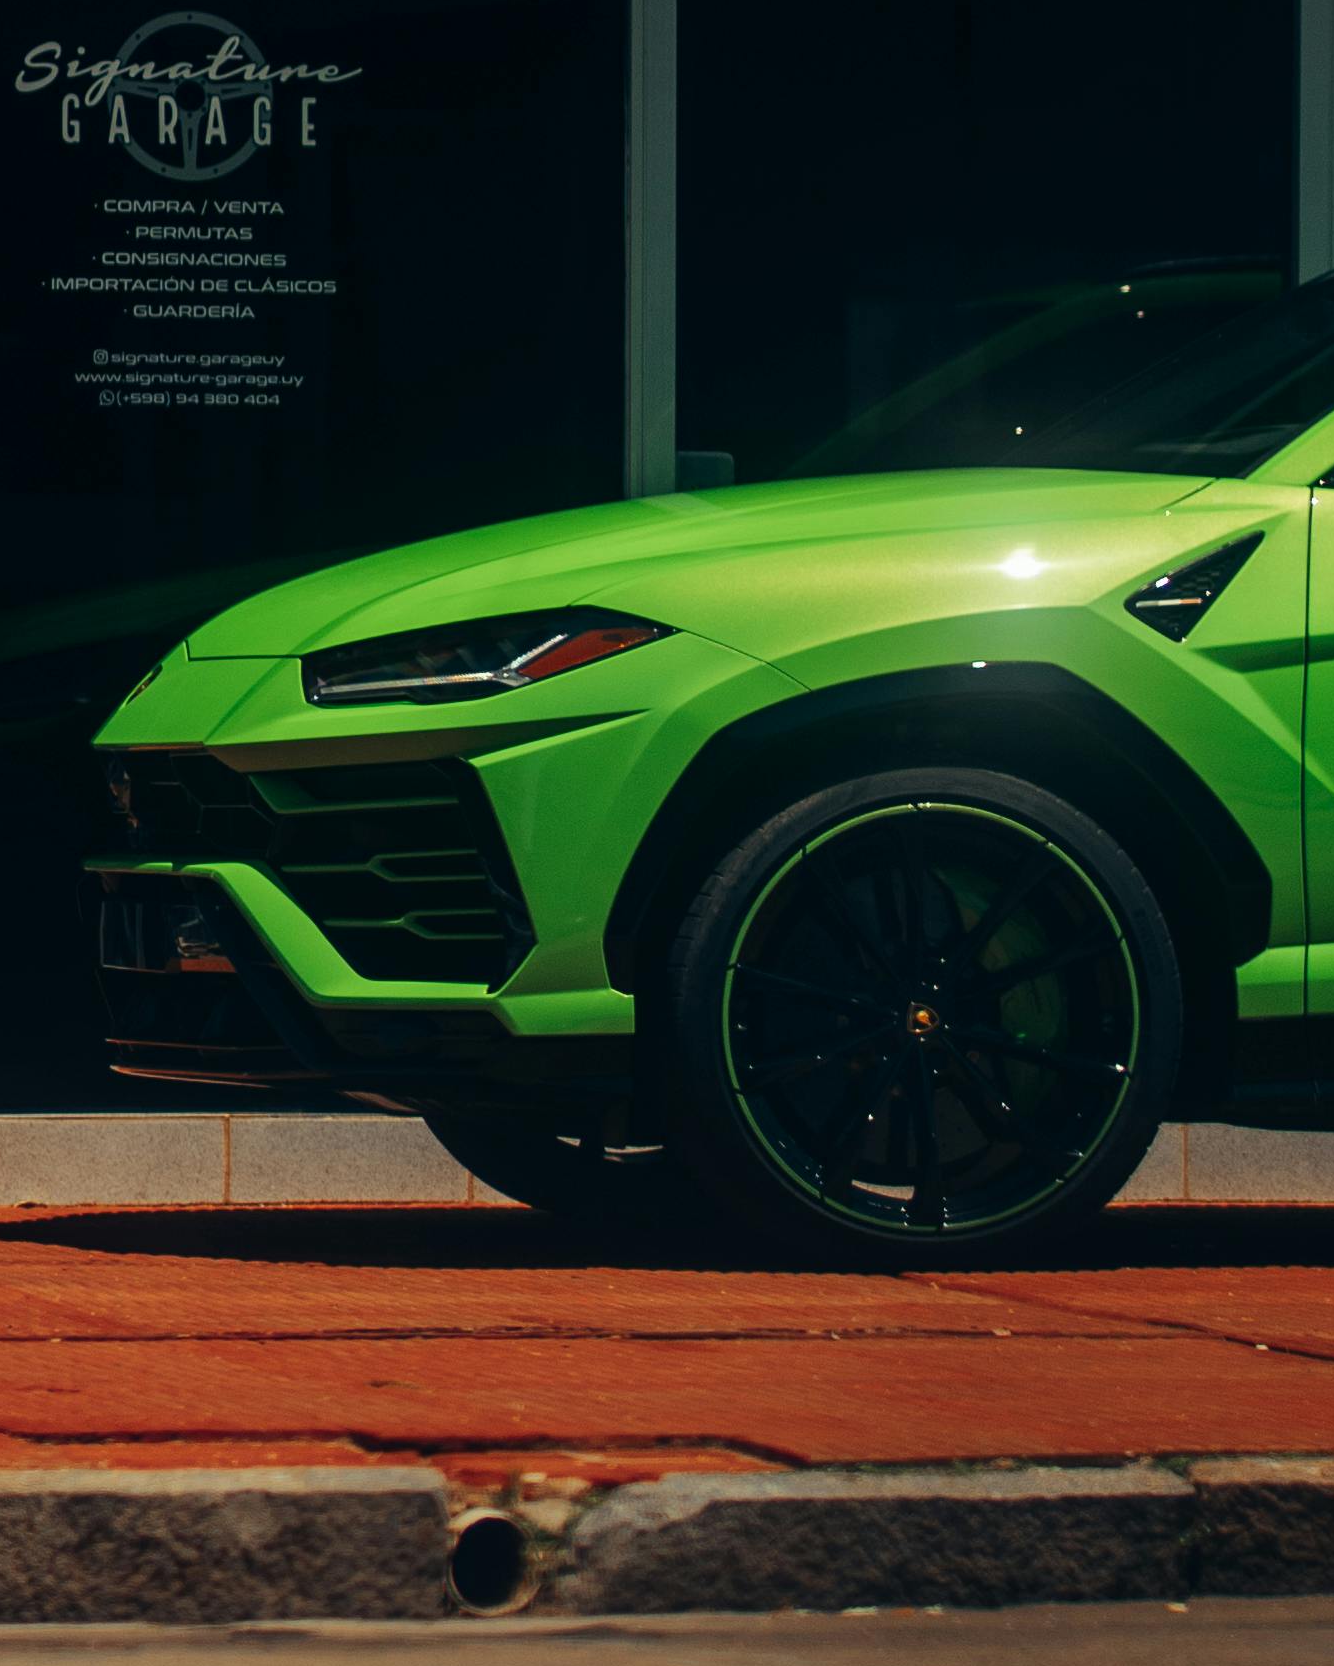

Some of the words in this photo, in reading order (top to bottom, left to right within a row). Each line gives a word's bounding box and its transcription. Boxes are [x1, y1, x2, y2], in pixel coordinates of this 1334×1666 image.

[15, 36, 362, 107] Signature
[61, 93, 318, 147] GARAGE
[103, 199, 196, 214] COMPRA
[213, 200, 285, 215] VENTA
[135, 226, 253, 241] PERMUTAS
[101, 251, 287, 267] CONSIGNACIONES
[51, 275, 195, 293] IMPORTACIÓN
[200, 279, 229, 292] DE
[234, 277, 337, 294] CLÁSICOS
[133, 302, 255, 319] GUARDERÍA
[74, 371, 304, 388] www.signature-garage.uy
[244, 394, 280, 405] 404
